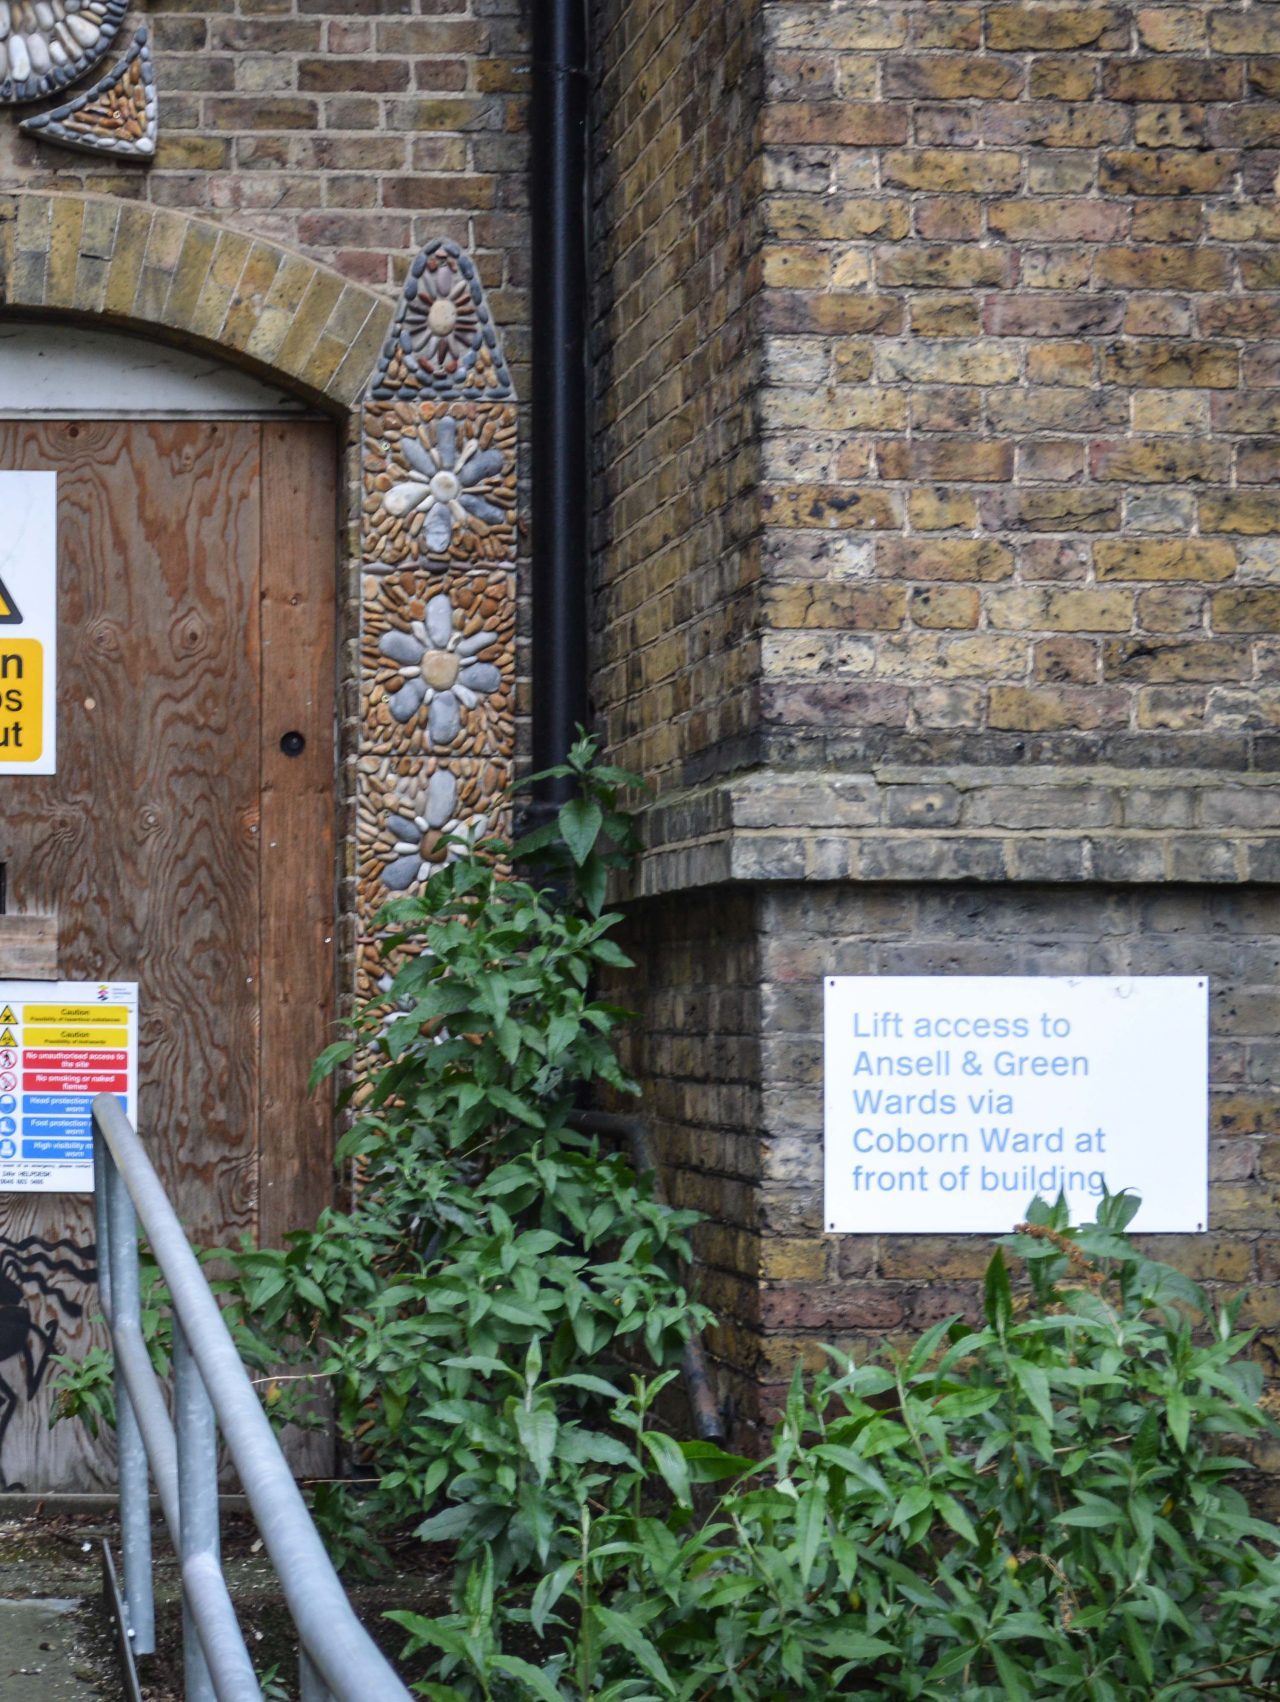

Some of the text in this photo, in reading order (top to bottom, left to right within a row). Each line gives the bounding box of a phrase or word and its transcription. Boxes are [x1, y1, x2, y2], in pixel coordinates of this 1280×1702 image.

[853, 1012, 1071, 1038] Lift access to
[38, 1052, 88, 1060] unauthorised
[853, 1050, 1089, 1076] Ansell & Green
[48, 1075, 80, 1084] smoking
[50, 1097, 89, 1106] protection
[853, 1089, 1014, 1115] Wards via
[49, 1120, 88, 1128] protection
[33, 1142, 52, 1150] High
[53, 1142, 84, 1150] visibility
[853, 1127, 1106, 1153] Coborn Ward at
[853, 1165, 1106, 1196] front of building
